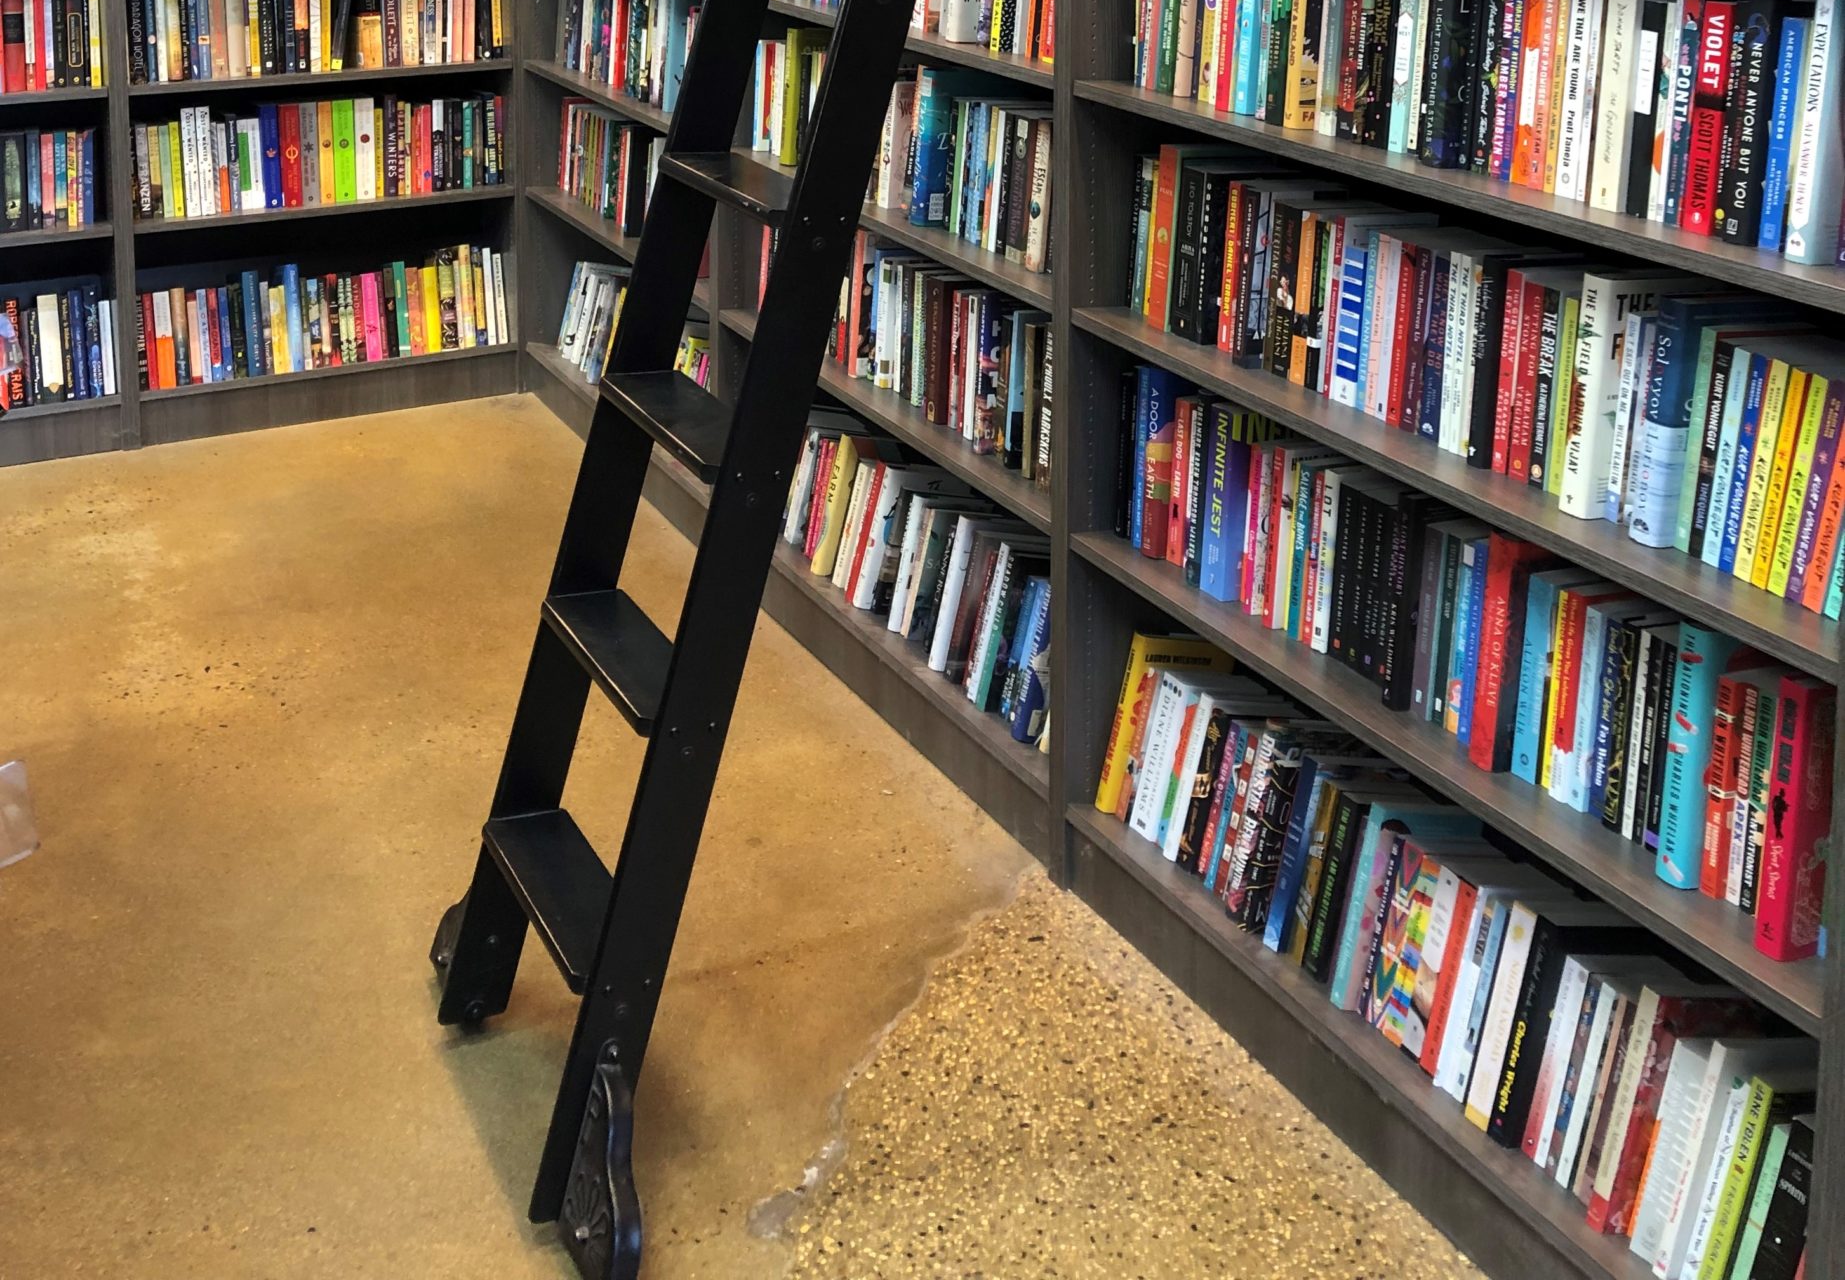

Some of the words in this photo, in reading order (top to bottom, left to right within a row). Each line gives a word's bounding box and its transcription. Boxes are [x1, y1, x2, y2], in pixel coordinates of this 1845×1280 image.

[1503, 14, 1514, 40] MAN
[1575, 18, 1585, 46] THAT
[1572, 47, 1582, 66] ARE
[1701, 15, 1726, 89] VIOLET
[1748, 42, 1763, 85] NEVER
[1783, 30, 1796, 86] AMERICAN
[1806, 22, 1828, 114] EXPECTATIONS
[1499, 54, 1509, 99] AMBER
[1568, 67, 1579, 102] YOUNG
[1673, 64, 1693, 125] PONTI
[1493, 102, 1506, 156] TAMBLYN
[1695, 112, 1715, 157] SCOTT
[1742, 89, 1757, 144] ANYONE
[1776, 87, 1789, 141] PRINCESS
[386, 133, 397, 179] WINTERS
[1739, 146, 1753, 175] BUT
[1690, 158, 1712, 211] THOMAS
[1734, 180, 1748, 210] YOU
[1370, 236, 1378, 272] CLOCK
[1365, 272, 1375, 312] DANCE
[1586, 288, 1597, 312] THE
[1363, 319, 1371, 344] ANNE
[1544, 312, 1558, 336] THE
[1358, 344, 1368, 383] TYLER
[1538, 337, 1555, 379] BREAK
[1579, 341, 1592, 380] FIELD
[1646, 333, 1672, 422] Solovyov
[1152, 387, 1159, 398] A
[1714, 372, 1725, 399] KURT
[1150, 402, 1158, 441] DOOR
[1573, 382, 1588, 436] MADHURI
[1705, 397, 1723, 452] VONNEGUT
[1038, 406, 1052, 469] BARKSKINS
[1213, 412, 1229, 493] INFINITE
[1566, 438, 1581, 476] VIJAY
[826, 465, 841, 506] FARM
[1738, 445, 1750, 485] KURT
[1299, 470, 1310, 513] SALVAGE
[1324, 484, 1333, 518] LOT
[1810, 475, 1823, 512] KURT
[1210, 497, 1223, 540] JEST
[1728, 483, 1745, 547] VONNEGUT
[1295, 521, 1305, 553] BONES
[1320, 531, 1328, 557] BRYAN
[1796, 510, 1817, 575] VONNEGUT
[1316, 558, 1327, 615] WASHINGTON
[1145, 655, 1171, 664] LAUREN
[1108, 707, 1124, 758] AMERICAN
[1154, 694, 1171, 741] DIANE
[1597, 723, 1609, 746] Fay
[1101, 760, 1113, 787] SPY
[1138, 743, 1160, 814] WILLIAMS
[1594, 747, 1608, 788] Weldon
[1732, 798, 1745, 844] APEX
[1508, 1020, 1528, 1064] Charles
[1497, 1063, 1520, 1115] Wright
[1750, 1084, 1765, 1120] JANE
[1738, 1122, 1757, 1164] YOLEN
